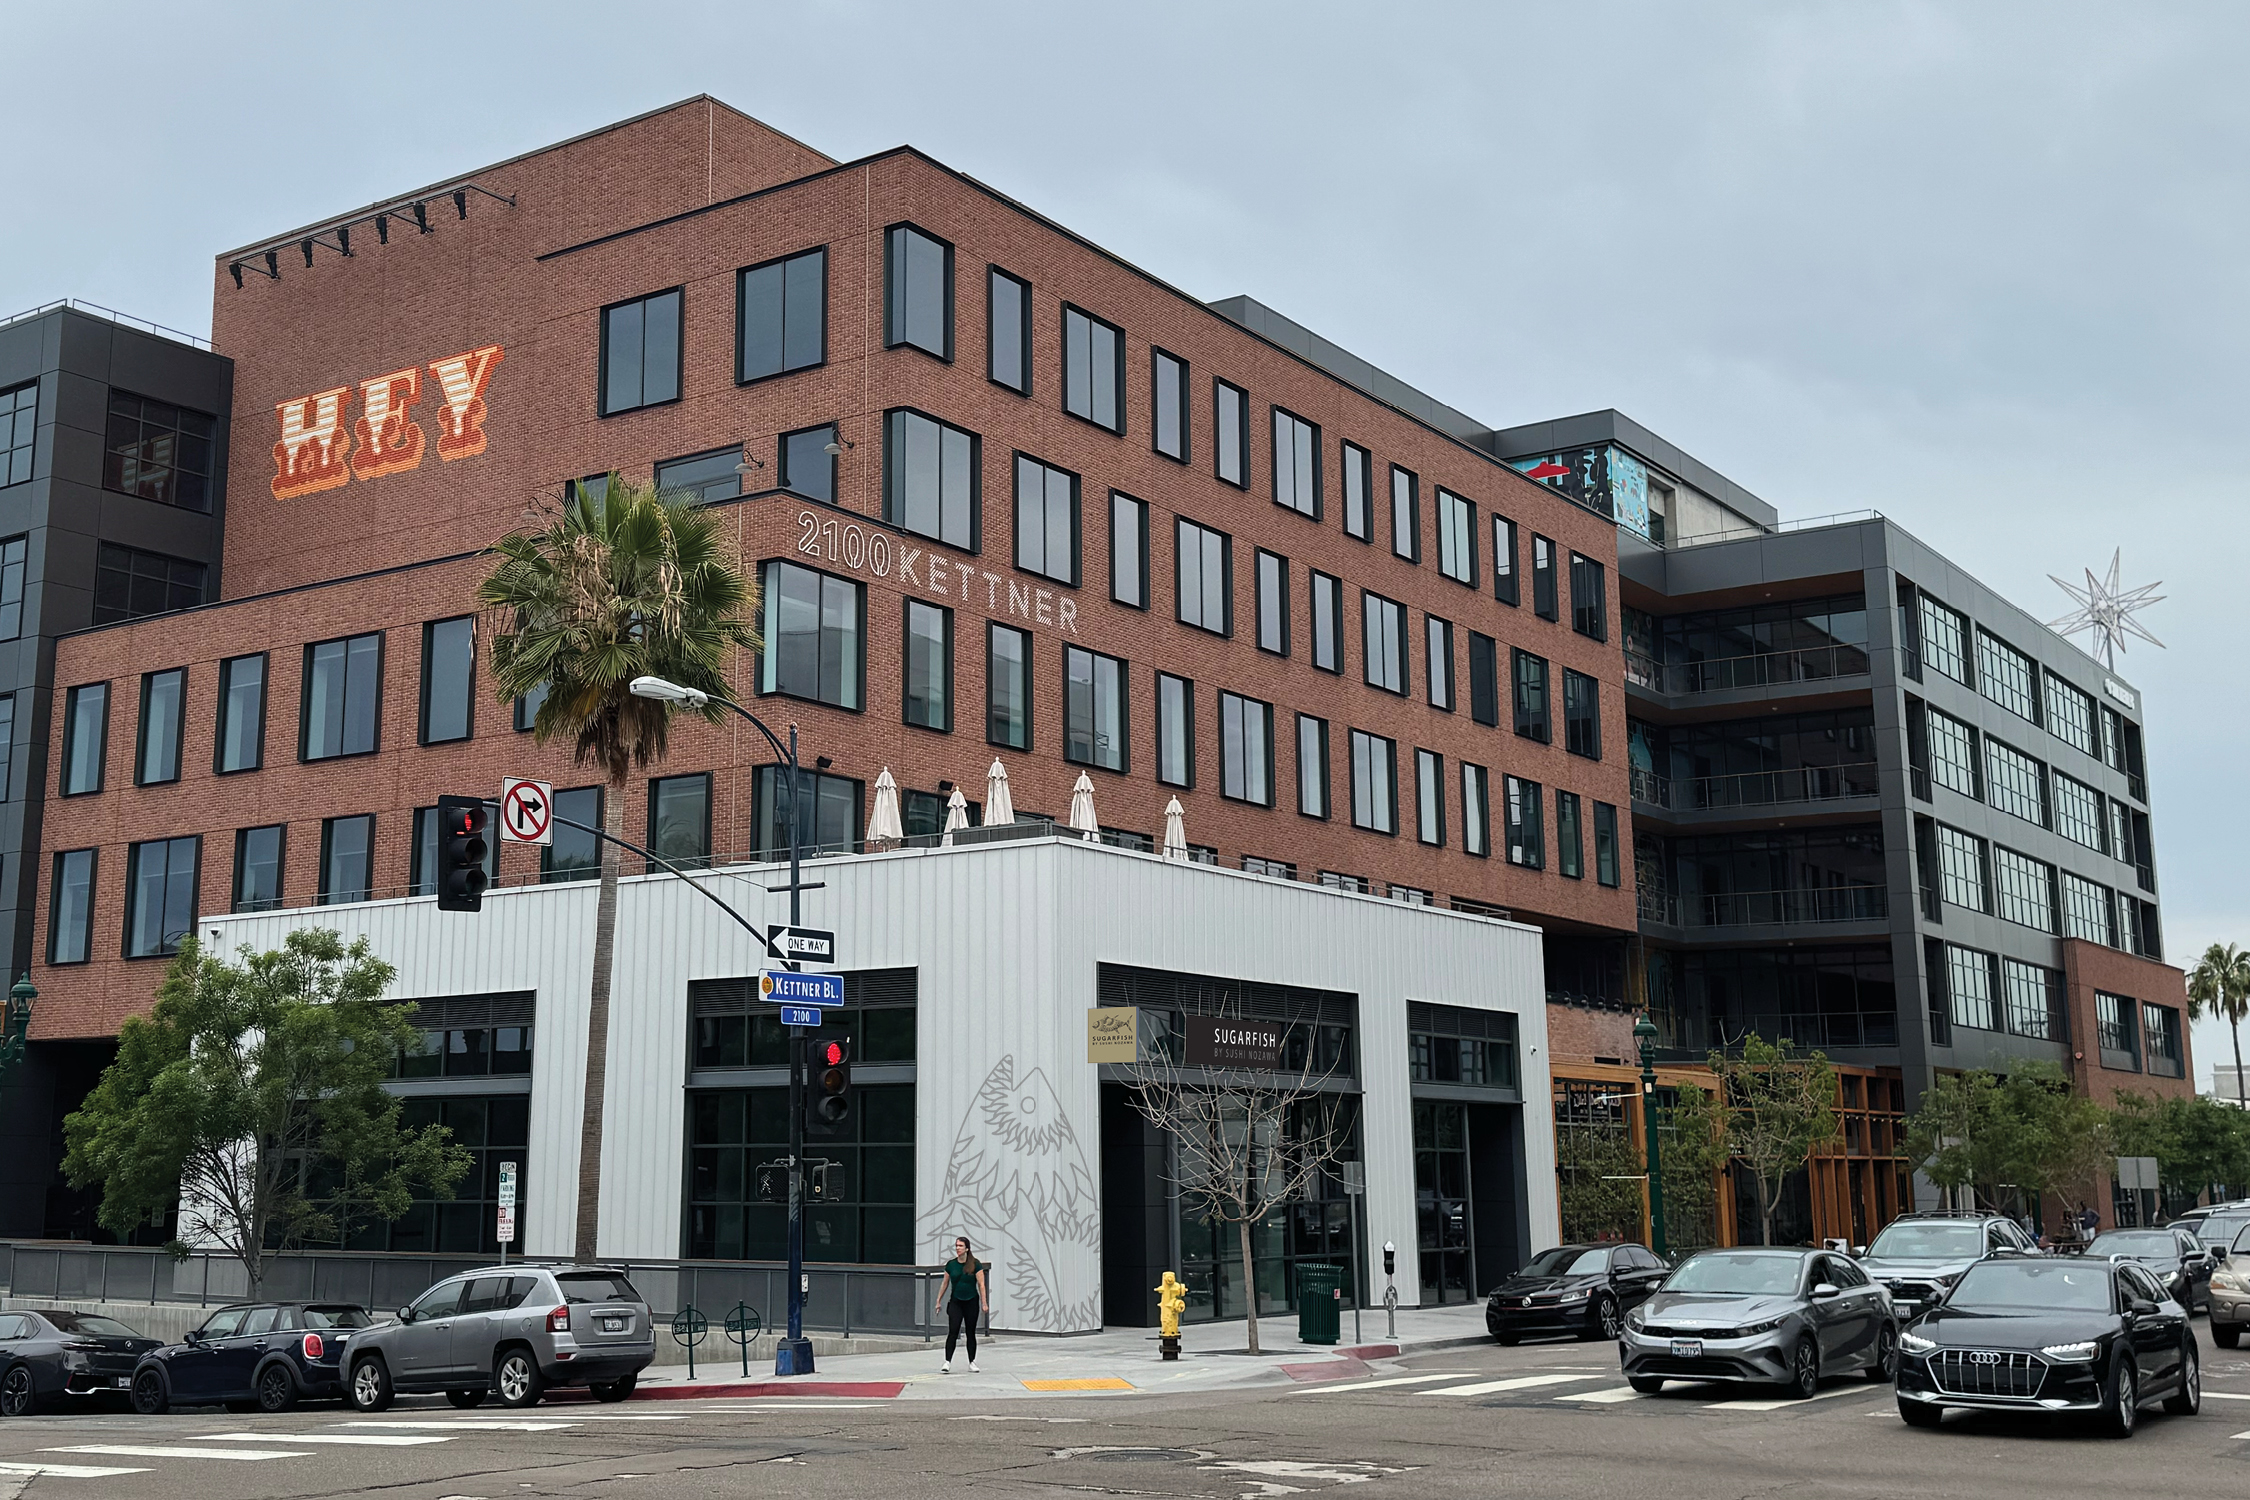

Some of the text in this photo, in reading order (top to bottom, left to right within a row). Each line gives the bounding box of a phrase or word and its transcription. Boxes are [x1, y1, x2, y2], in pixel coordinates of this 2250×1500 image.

[271, 343, 504, 500] HEY
[798, 511, 1078, 634] 2100 KETTNER
[788, 938, 825, 952] ONE WAY
[775, 977, 839, 999] KETTNER BL.
[793, 1010, 810, 1022] 2100
[1214, 1028, 1276, 1048] SUGARFISH
[1214, 1048, 1276, 1061] BY SUSHI NOZAWA
